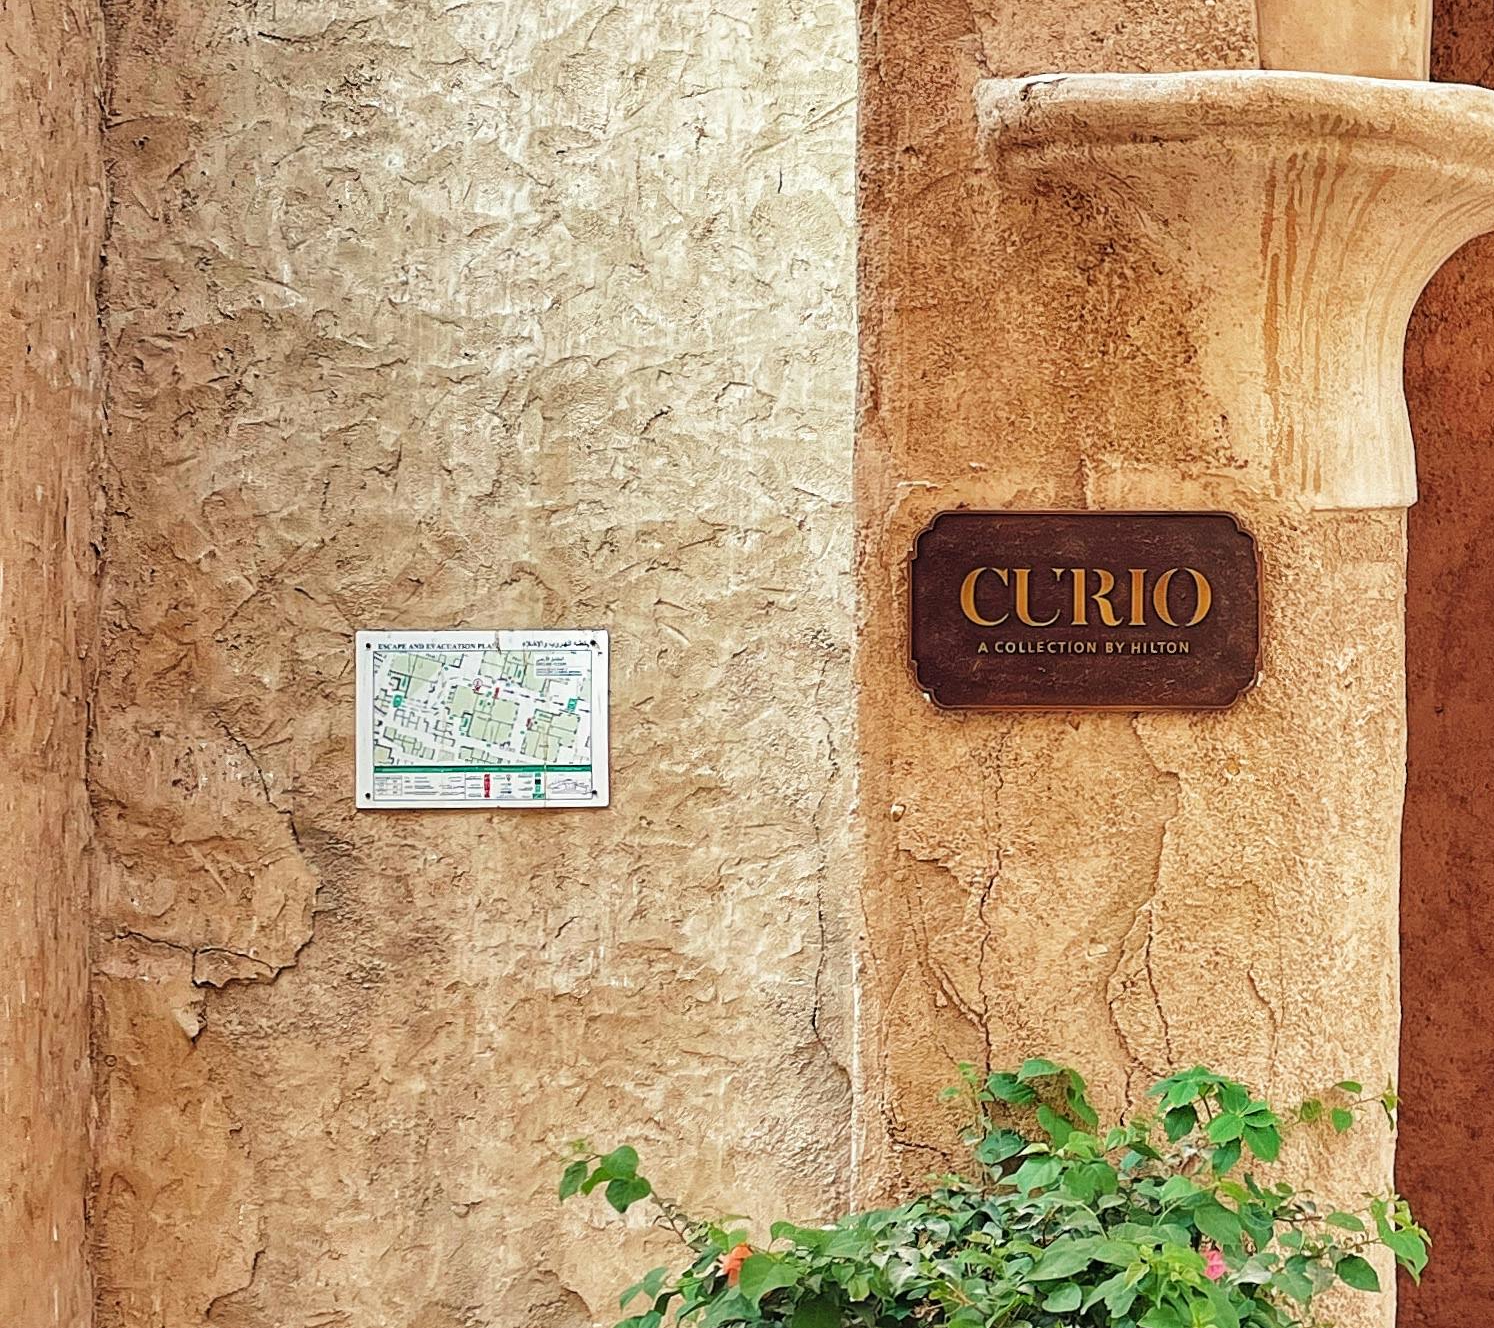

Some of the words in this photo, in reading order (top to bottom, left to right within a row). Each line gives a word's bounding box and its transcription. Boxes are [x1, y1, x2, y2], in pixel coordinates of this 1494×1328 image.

[959, 566, 1212, 627] CURIO
[977, 641, 989, 654] A
[994, 641, 1097, 654] COLLECTION
[1105, 641, 1125, 654] BY
[1131, 641, 1190, 654] HILTON
